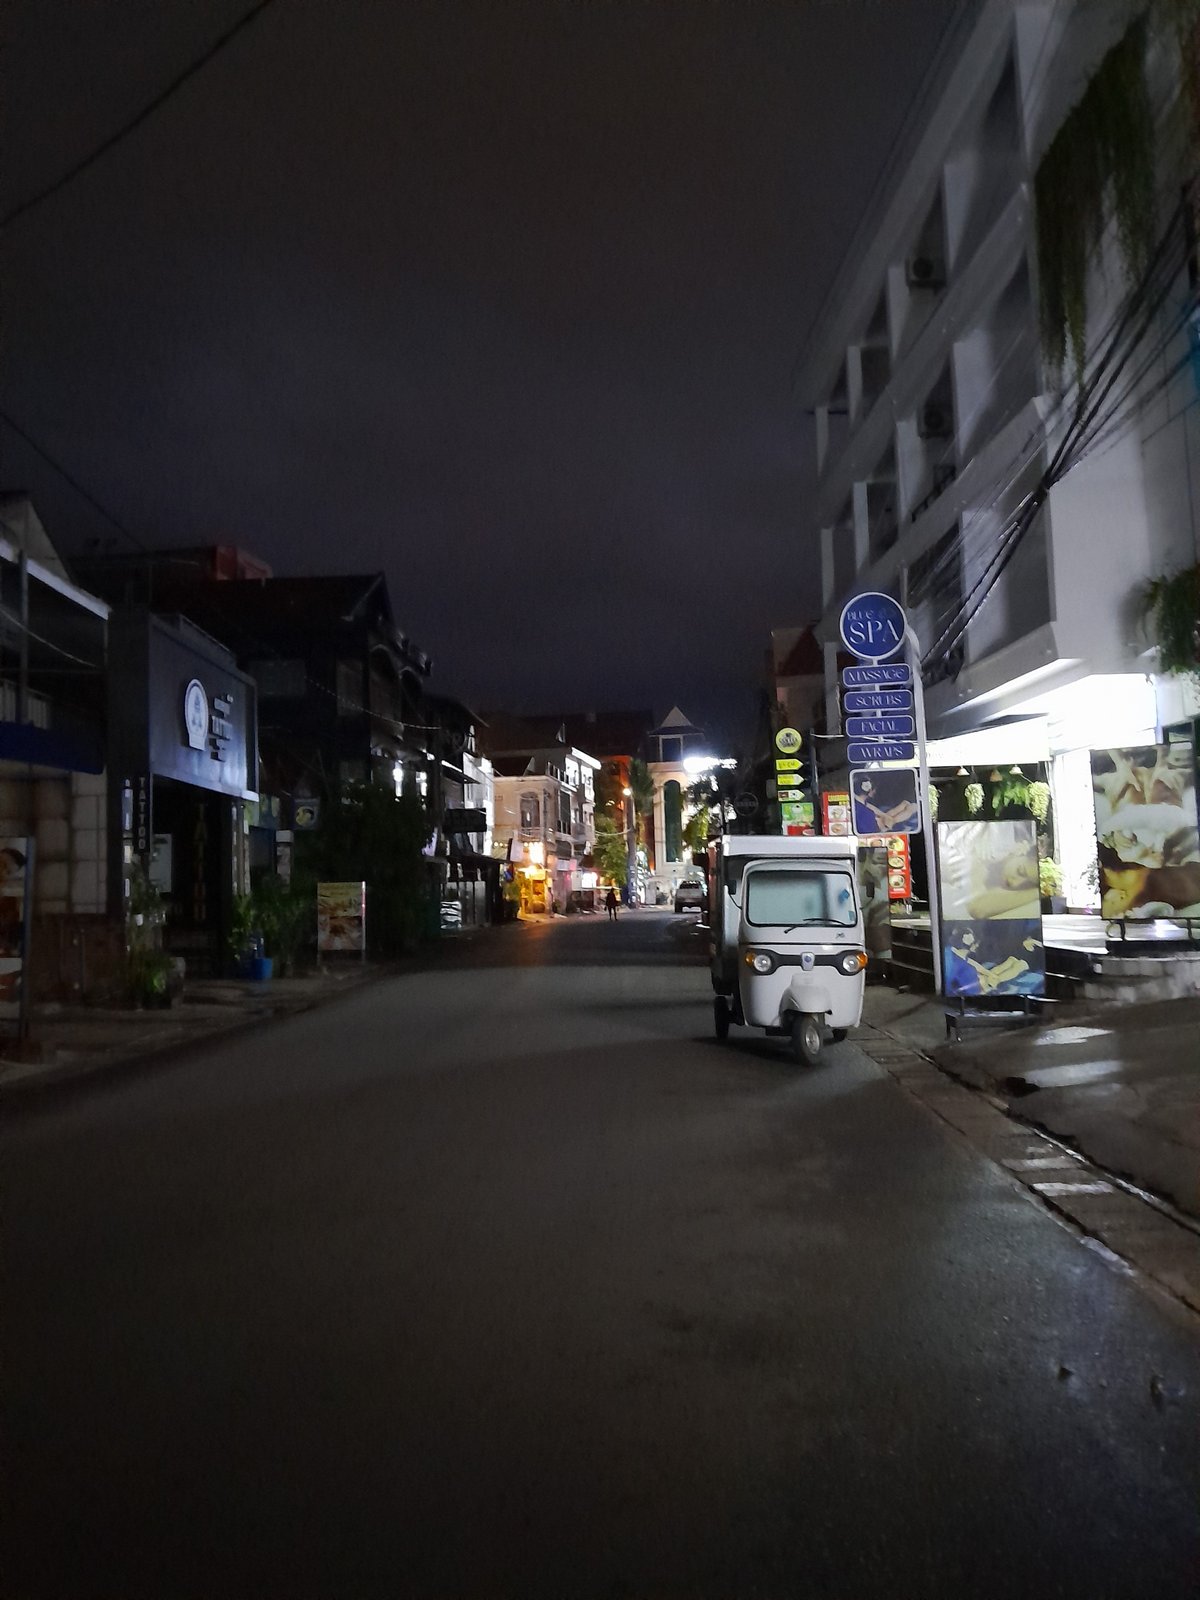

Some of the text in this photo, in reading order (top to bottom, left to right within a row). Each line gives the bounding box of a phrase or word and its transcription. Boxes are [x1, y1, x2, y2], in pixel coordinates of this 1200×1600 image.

[849, 619, 900, 645] SPA
[848, 667, 905, 683] MASSAGE
[855, 694, 903, 707] SCRUBS
[861, 720, 898, 733] FACIAL
[860, 745, 904, 759] WRAPS
[138, 776, 146, 850] TATTOO
